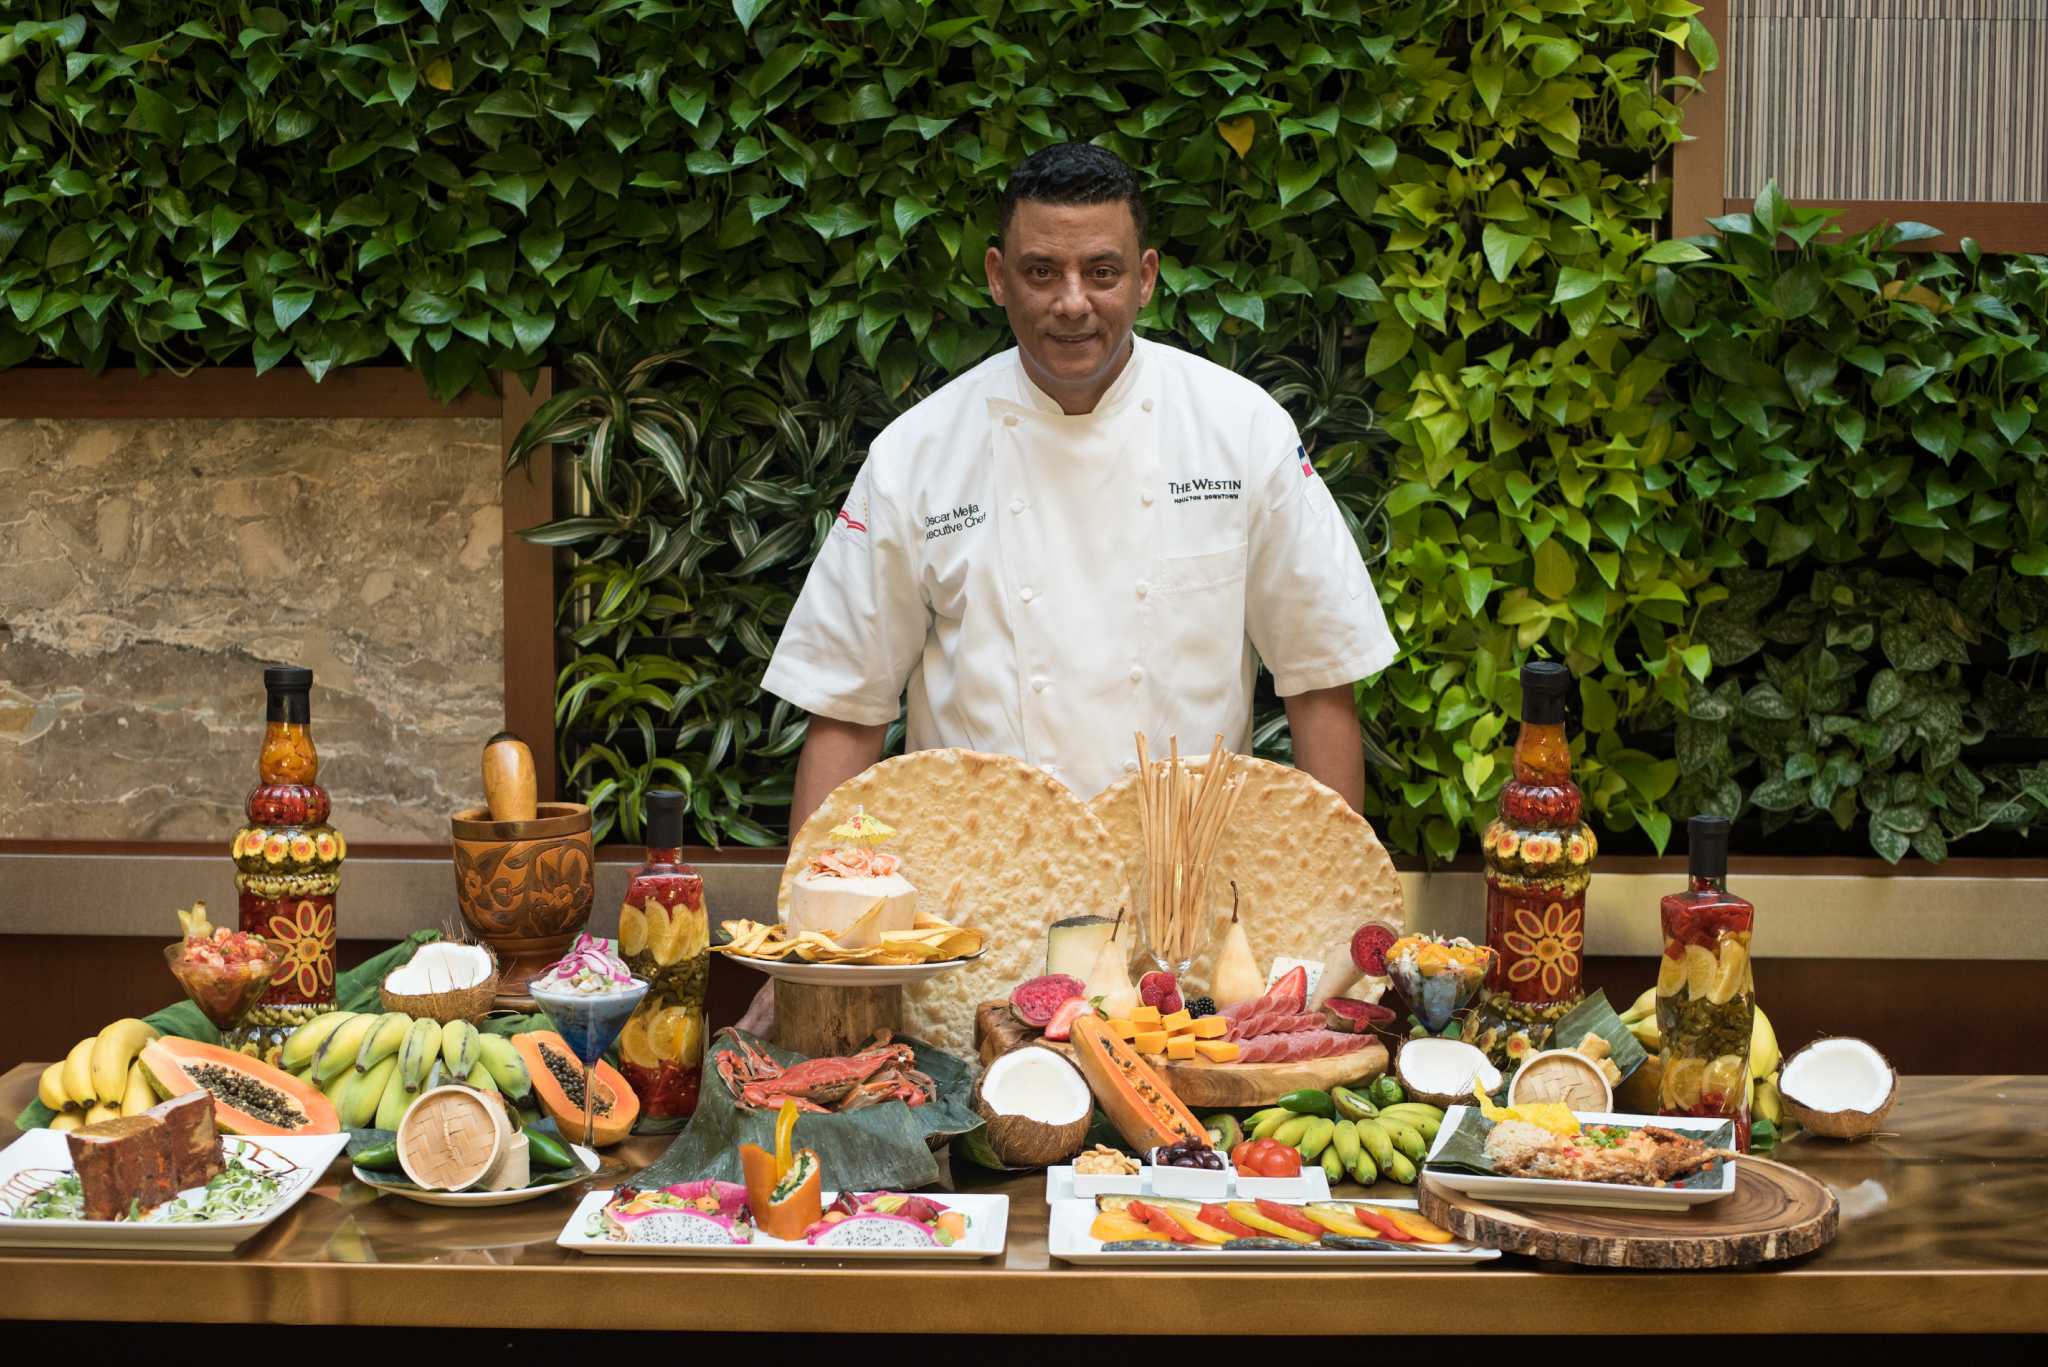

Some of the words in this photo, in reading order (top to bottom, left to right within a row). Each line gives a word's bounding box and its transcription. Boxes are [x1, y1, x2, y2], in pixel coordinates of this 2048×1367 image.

[1168, 482, 1192, 494] THE
[1192, 478, 1241, 490] WESTIN
[964, 512, 986, 528] Chef
